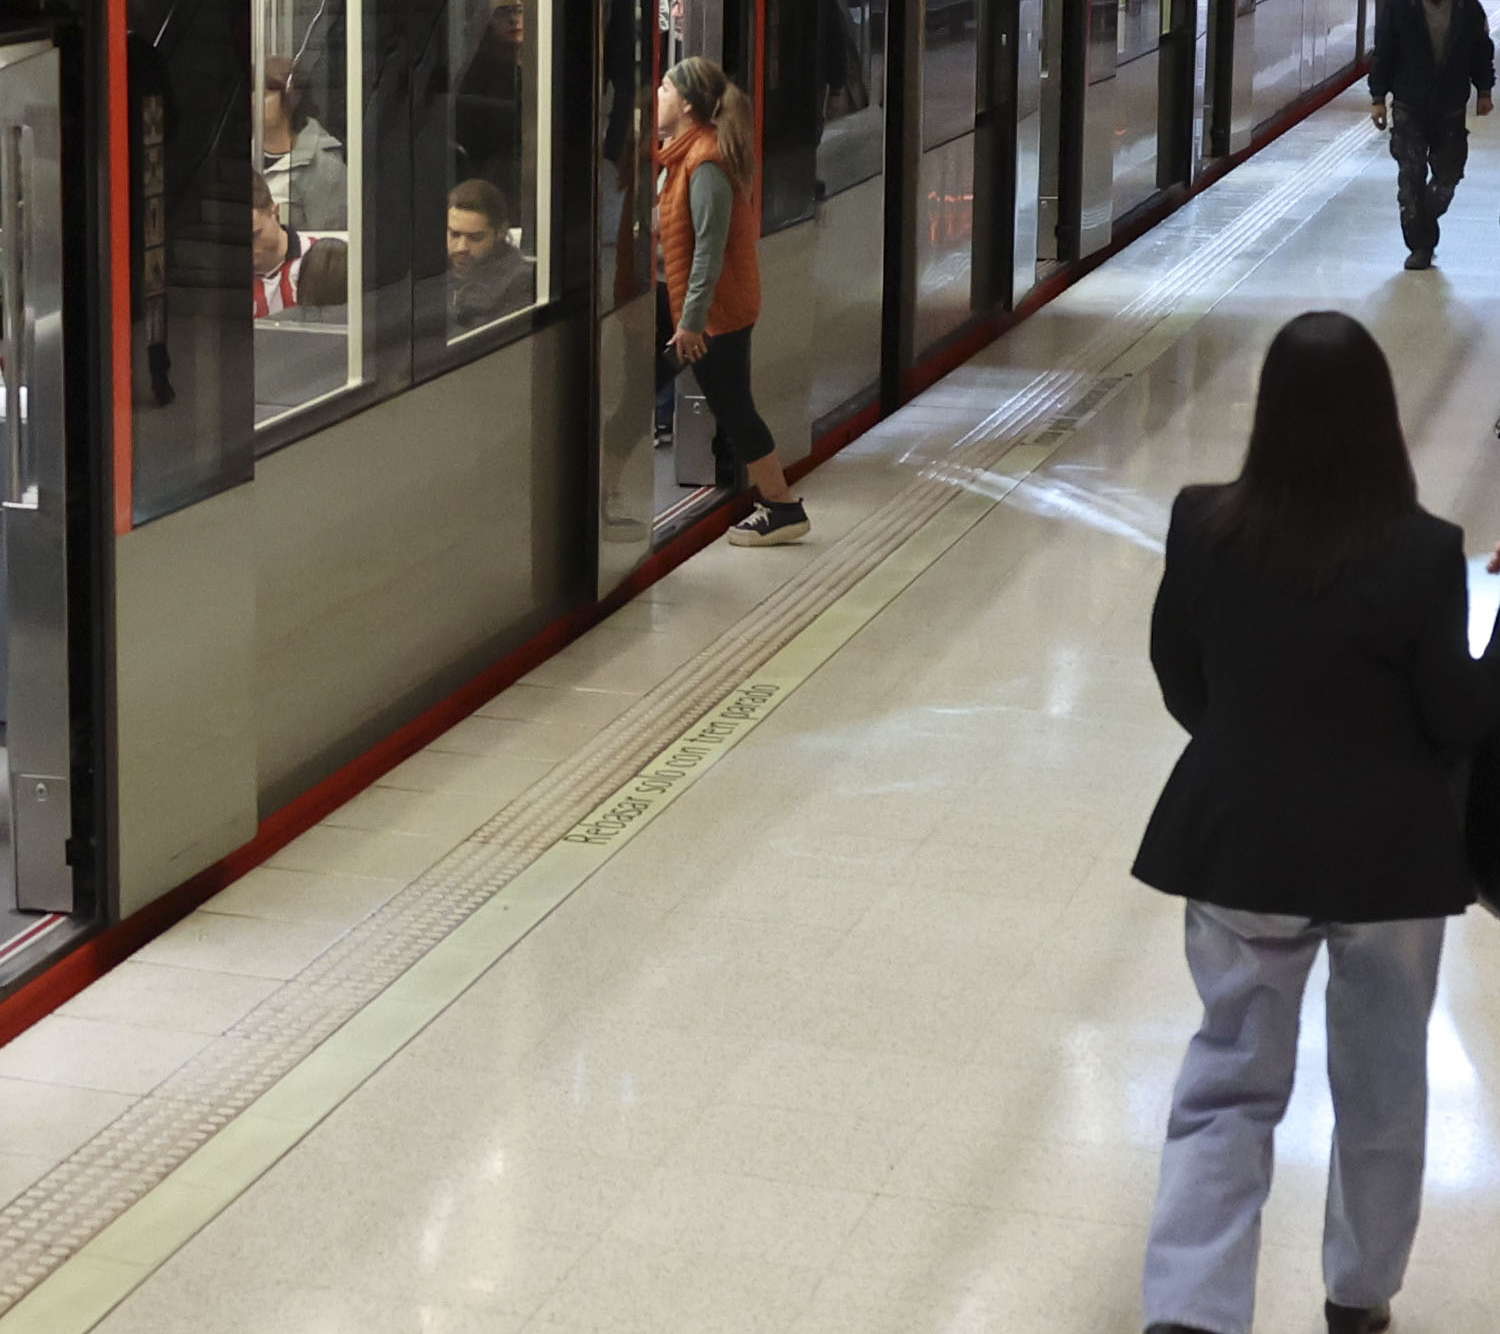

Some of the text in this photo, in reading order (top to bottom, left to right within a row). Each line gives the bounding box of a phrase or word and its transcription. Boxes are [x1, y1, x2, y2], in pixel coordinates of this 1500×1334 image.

[563, 683, 781, 846] Rebasar solo con tren parado
